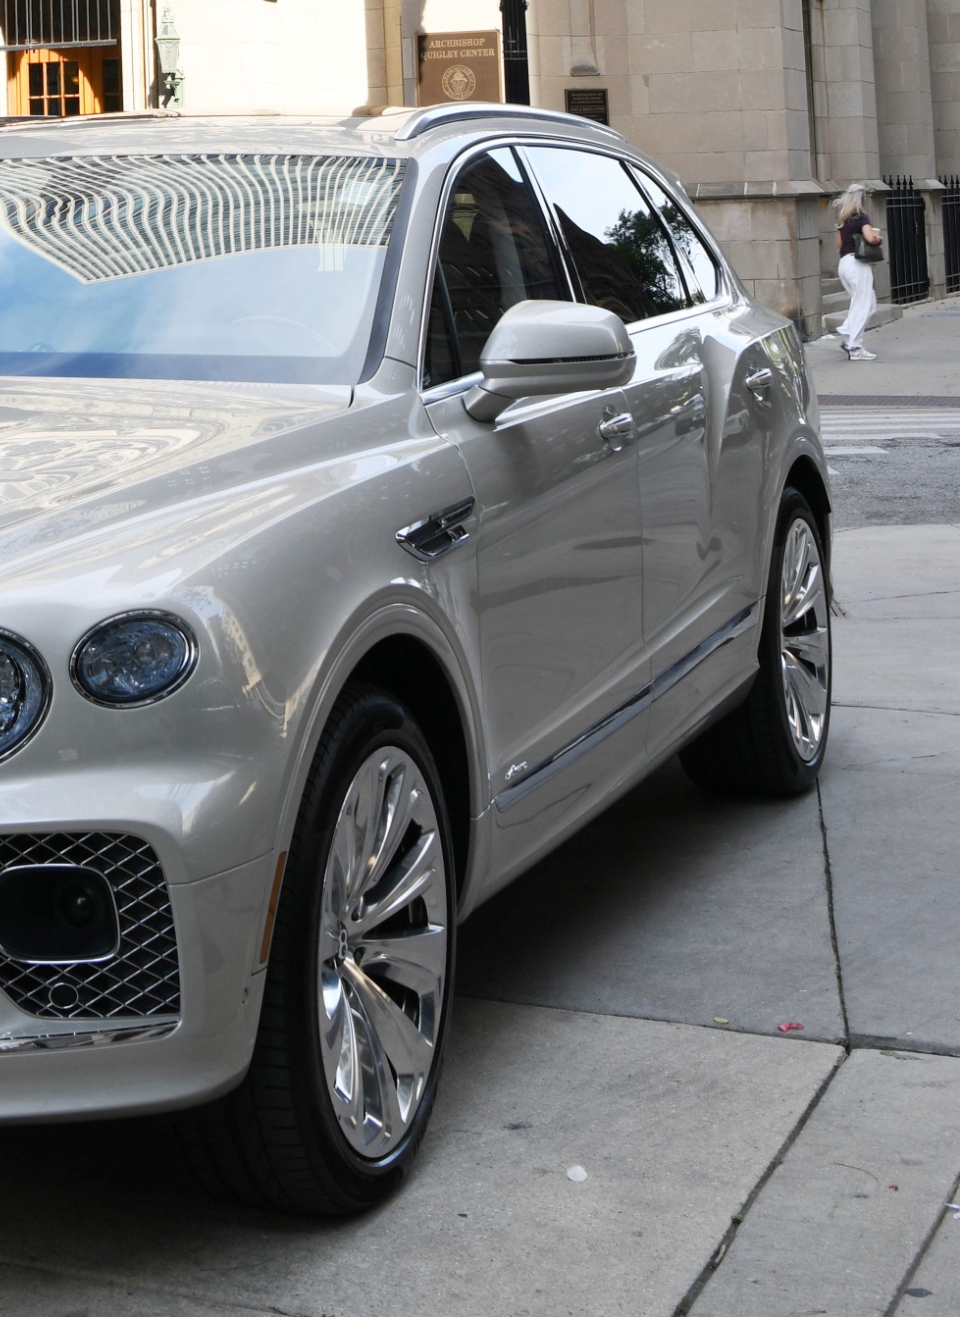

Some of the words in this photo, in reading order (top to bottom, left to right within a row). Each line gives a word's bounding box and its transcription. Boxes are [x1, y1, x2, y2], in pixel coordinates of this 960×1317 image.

[429, 37, 486, 49] ARCHBISHOP
[421, 49, 458, 60] QUIGLEY
[459, 47, 495, 58] CENTER
